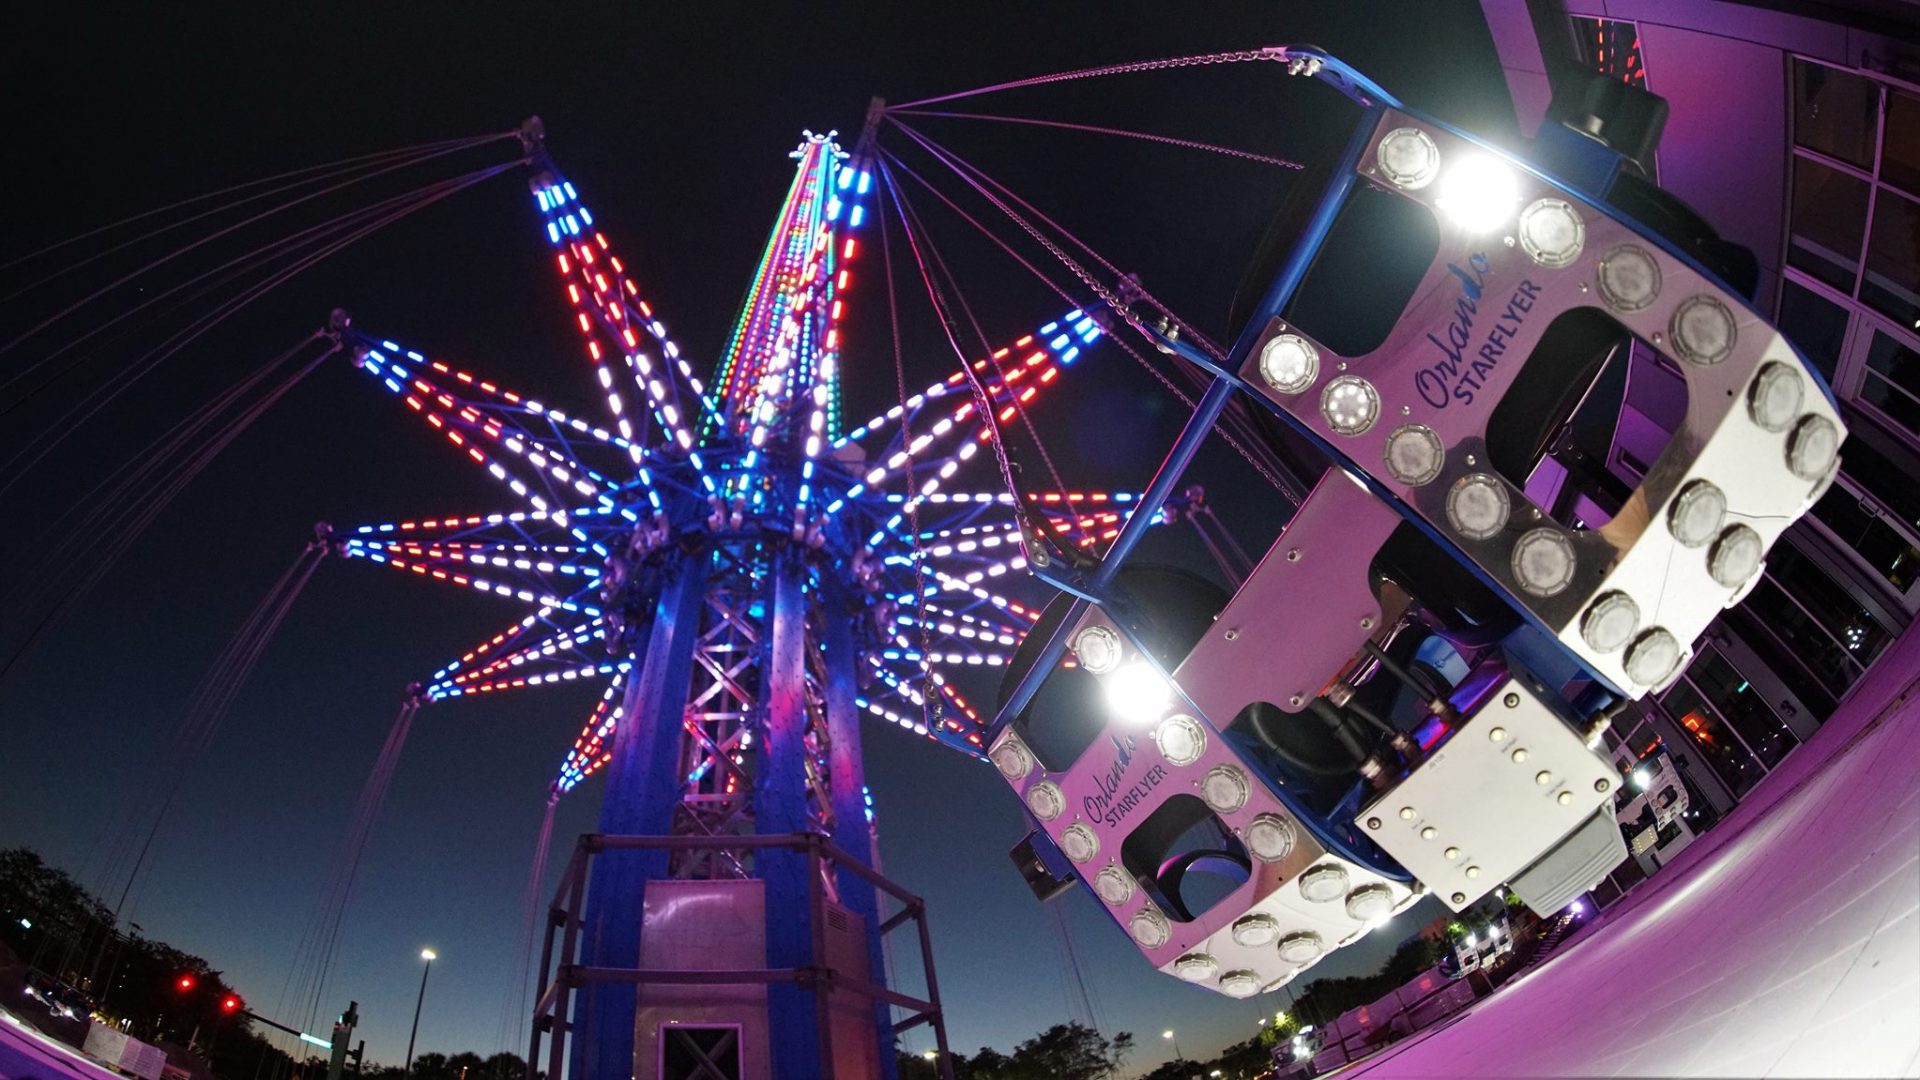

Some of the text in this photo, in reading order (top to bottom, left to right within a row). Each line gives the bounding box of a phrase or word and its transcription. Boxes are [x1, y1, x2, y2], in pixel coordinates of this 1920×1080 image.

[1415, 253, 1489, 409] Orlando
[1453, 279, 1542, 405] STARFLYER
[1105, 764, 1168, 828] STARFLYER
